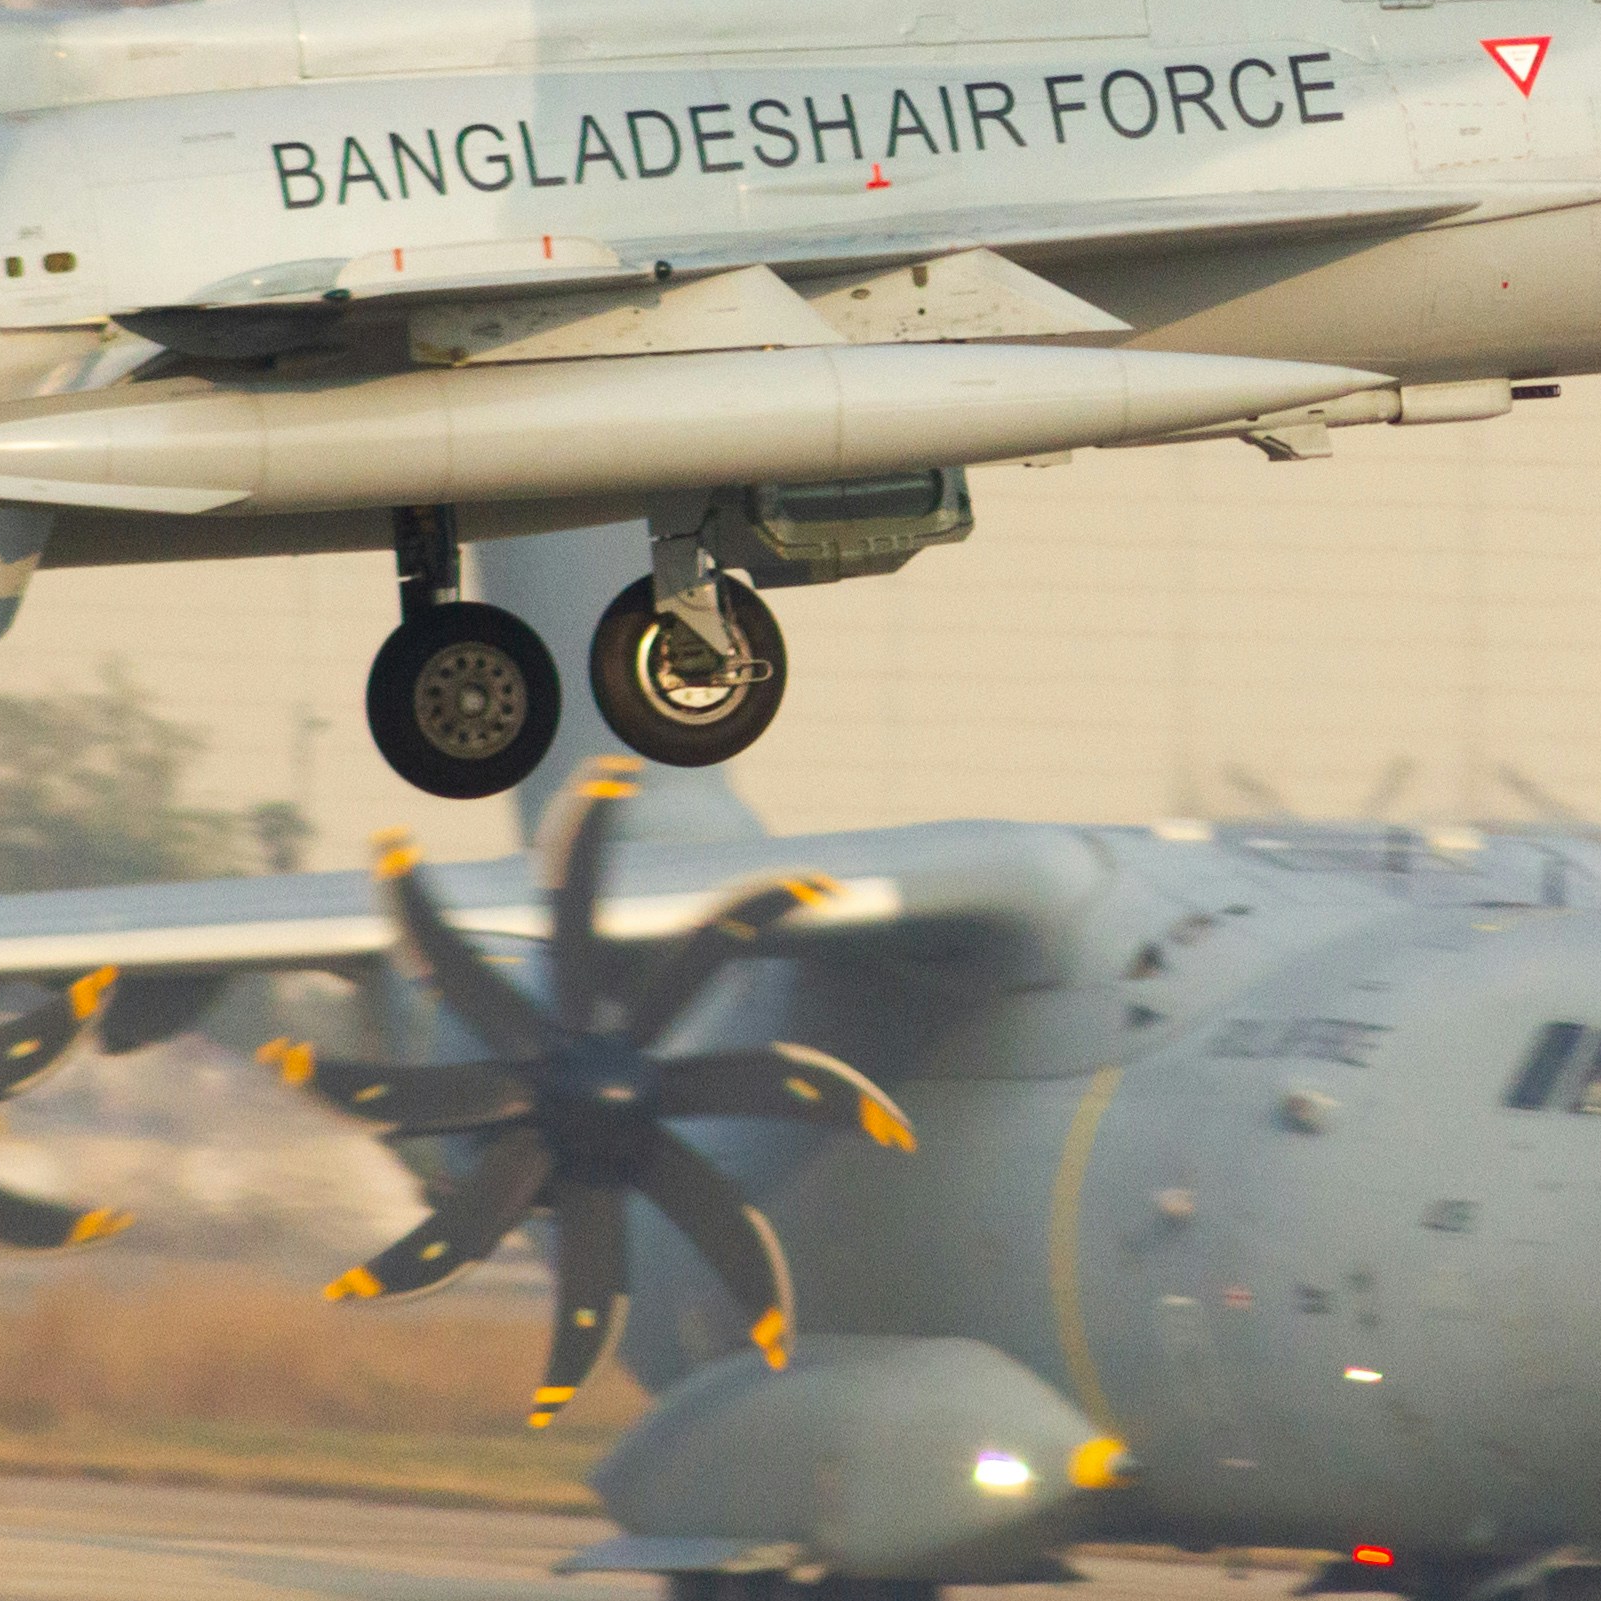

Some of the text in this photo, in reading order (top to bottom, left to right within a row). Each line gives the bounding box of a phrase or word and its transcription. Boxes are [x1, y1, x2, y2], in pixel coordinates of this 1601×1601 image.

[270, 51, 1346, 211] BANGLADESH AIR FORCE
